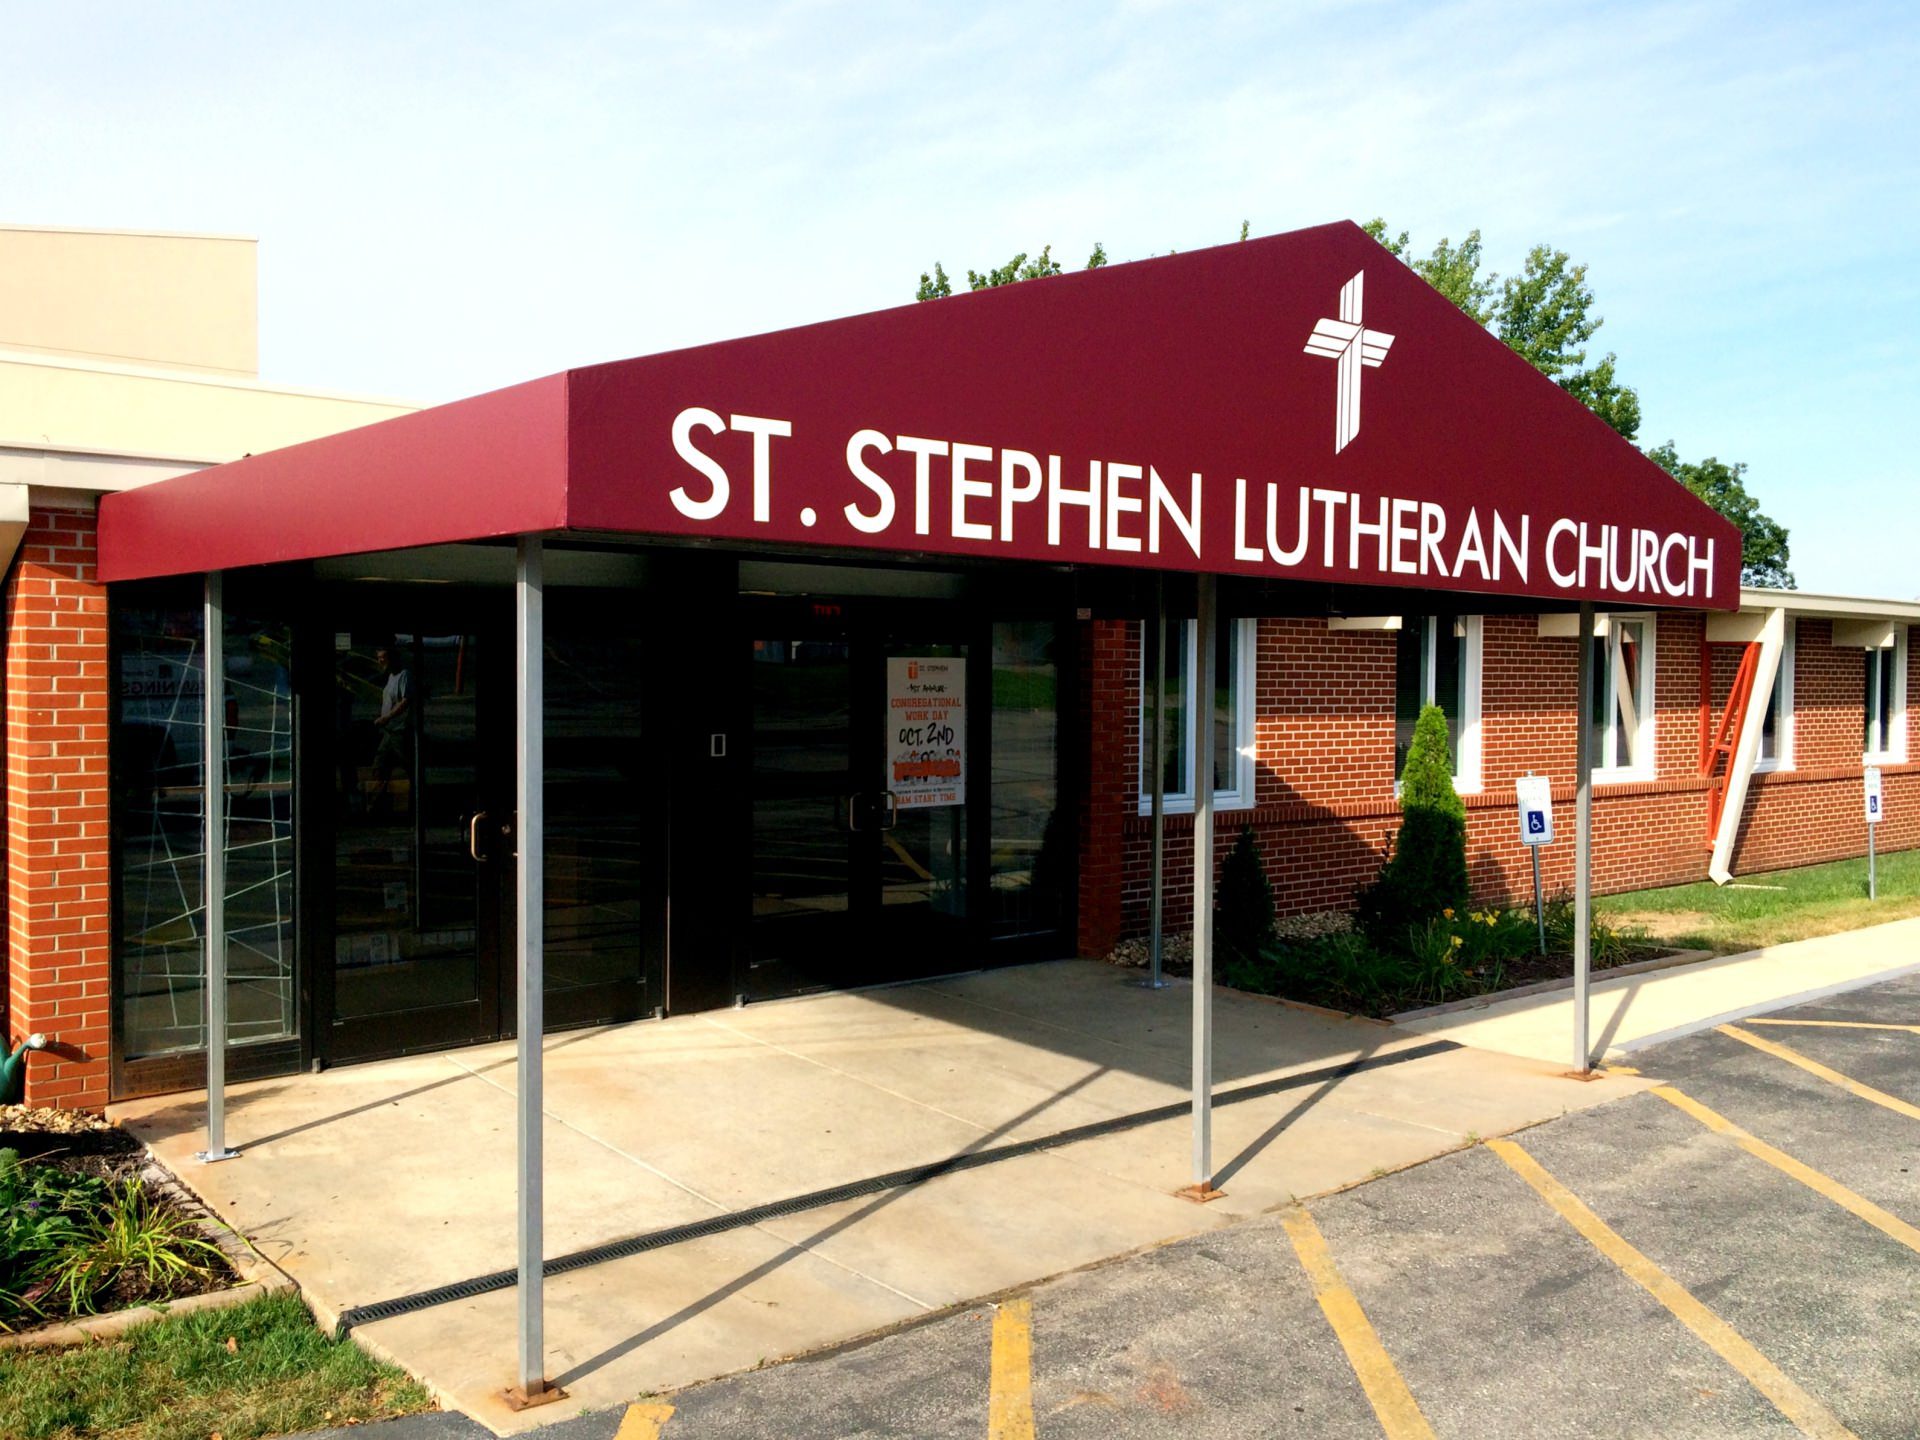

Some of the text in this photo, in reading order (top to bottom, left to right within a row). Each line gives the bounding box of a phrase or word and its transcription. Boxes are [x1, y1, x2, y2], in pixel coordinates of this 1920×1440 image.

[669, 407, 1714, 598] ST. STEPHEN LUTHERAN CHURCH
[891, 697, 961, 708] CONGREGATIONAL
[905, 711, 949, 721] WORK DAY
[899, 722, 954, 746] OCT. 2ND
[914, 793, 936, 802] START
[940, 792, 957, 801] TIME
